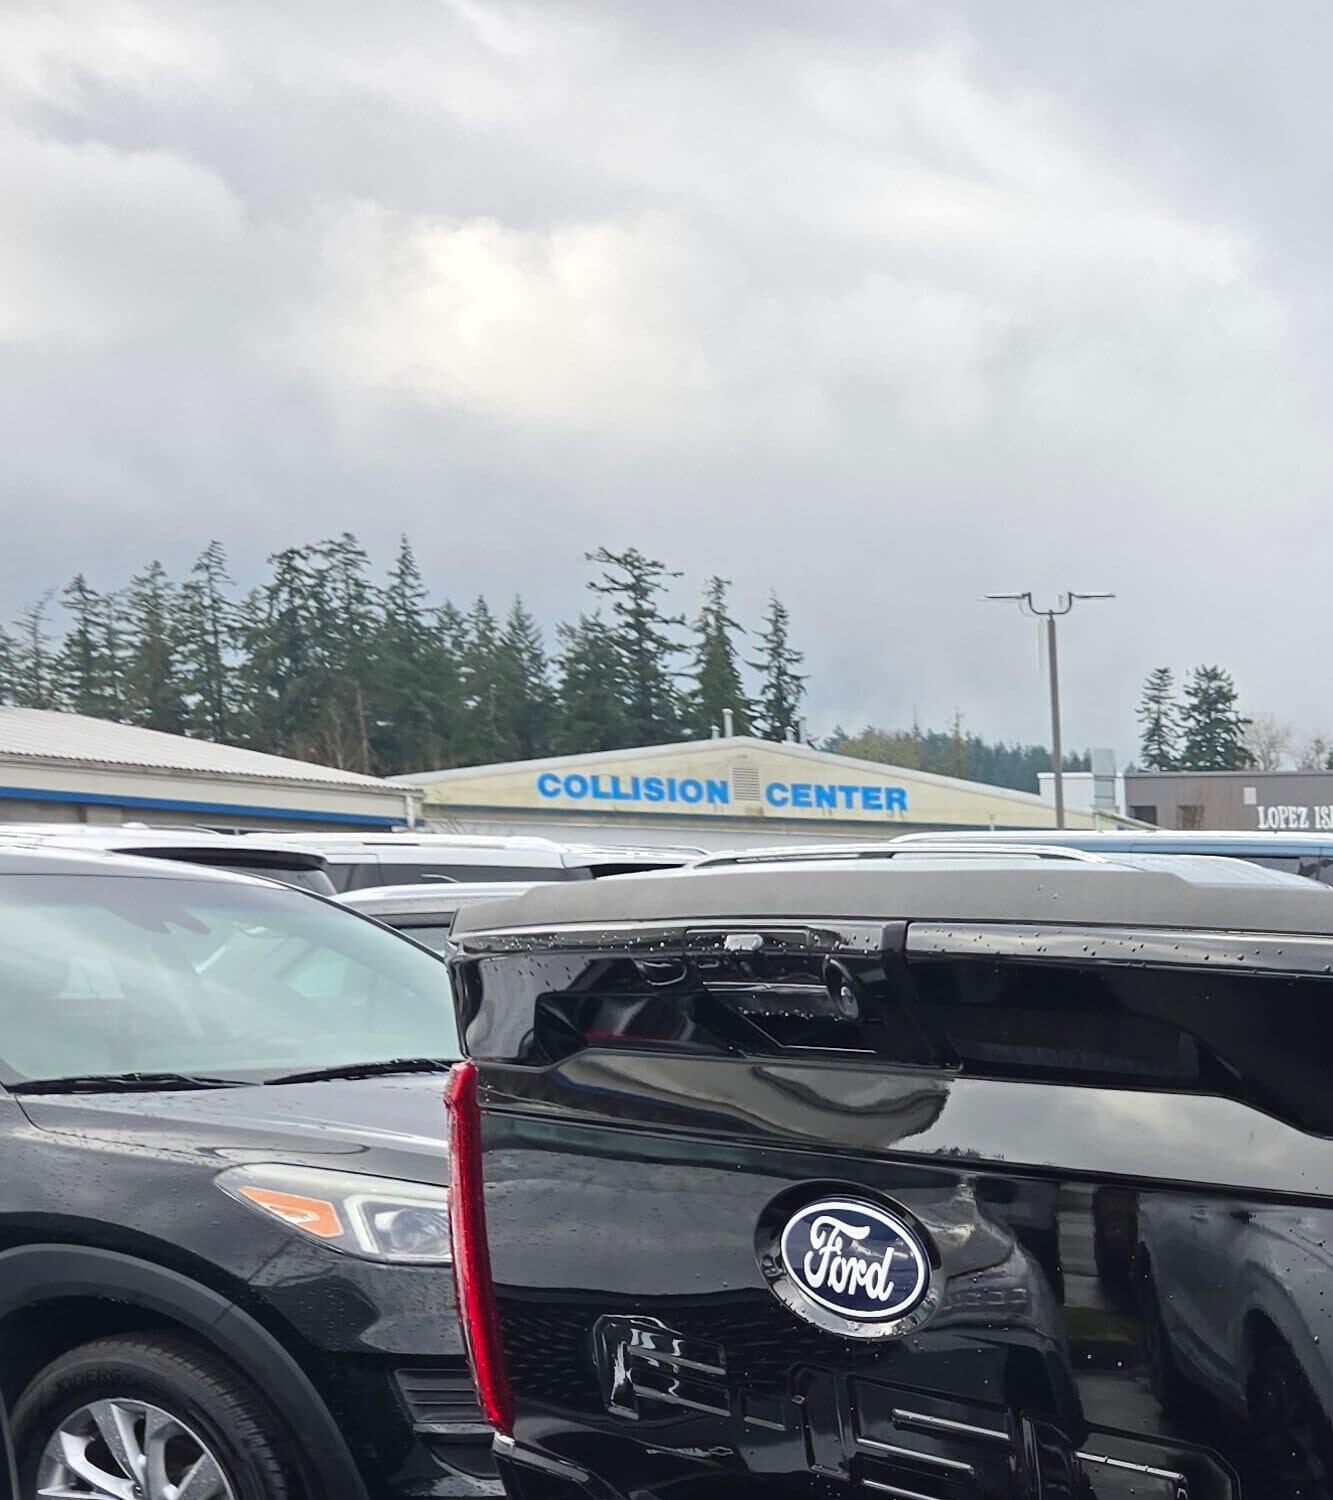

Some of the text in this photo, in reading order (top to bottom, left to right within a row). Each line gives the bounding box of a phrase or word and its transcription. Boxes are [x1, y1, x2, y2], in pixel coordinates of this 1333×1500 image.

[536, 773, 908, 812] COLLISION CENTER
[1256, 805, 1310, 829] LOPEZ
[803, 1215, 896, 1302] Ford
